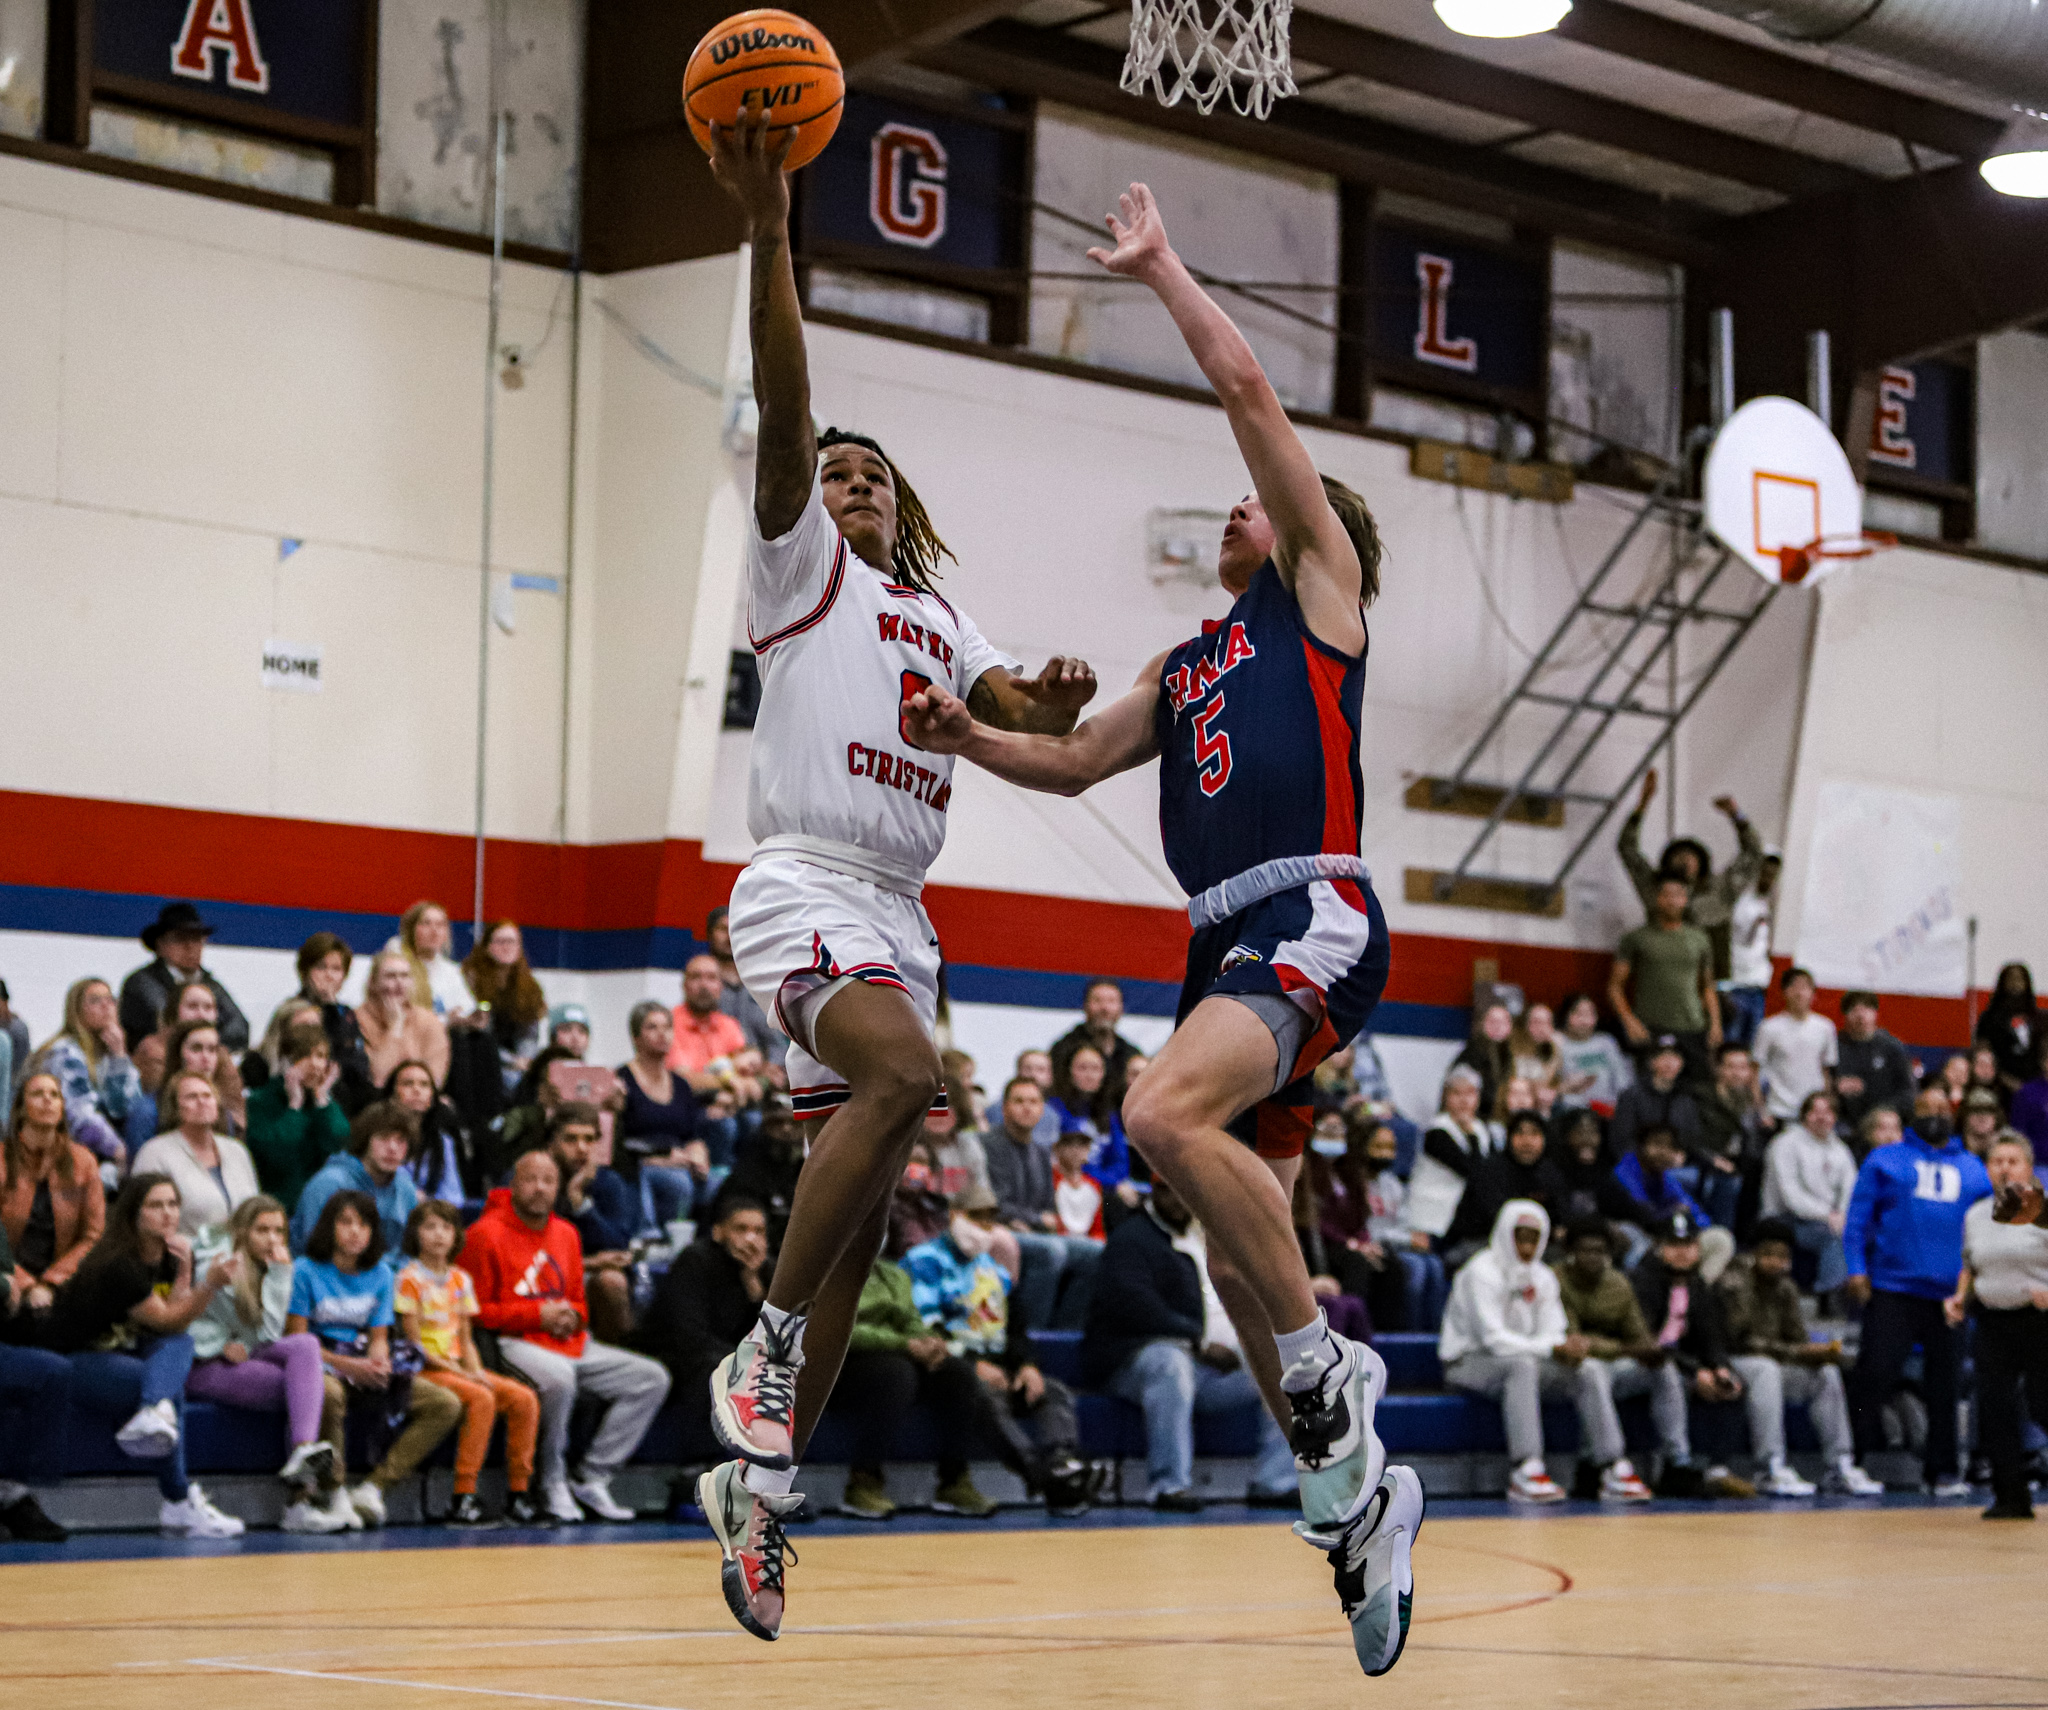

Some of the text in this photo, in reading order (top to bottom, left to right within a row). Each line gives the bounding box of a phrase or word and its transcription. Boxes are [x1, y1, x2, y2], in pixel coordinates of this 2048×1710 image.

[170, 0, 269, 94] A
[710, 28, 817, 65] Wilson
[870, 122, 947, 249] G
[1414, 252, 1478, 371] L
[1868, 365, 1917, 470] E
[262, 654, 319, 680] HOME
[1191, 690, 1233, 797] 5
